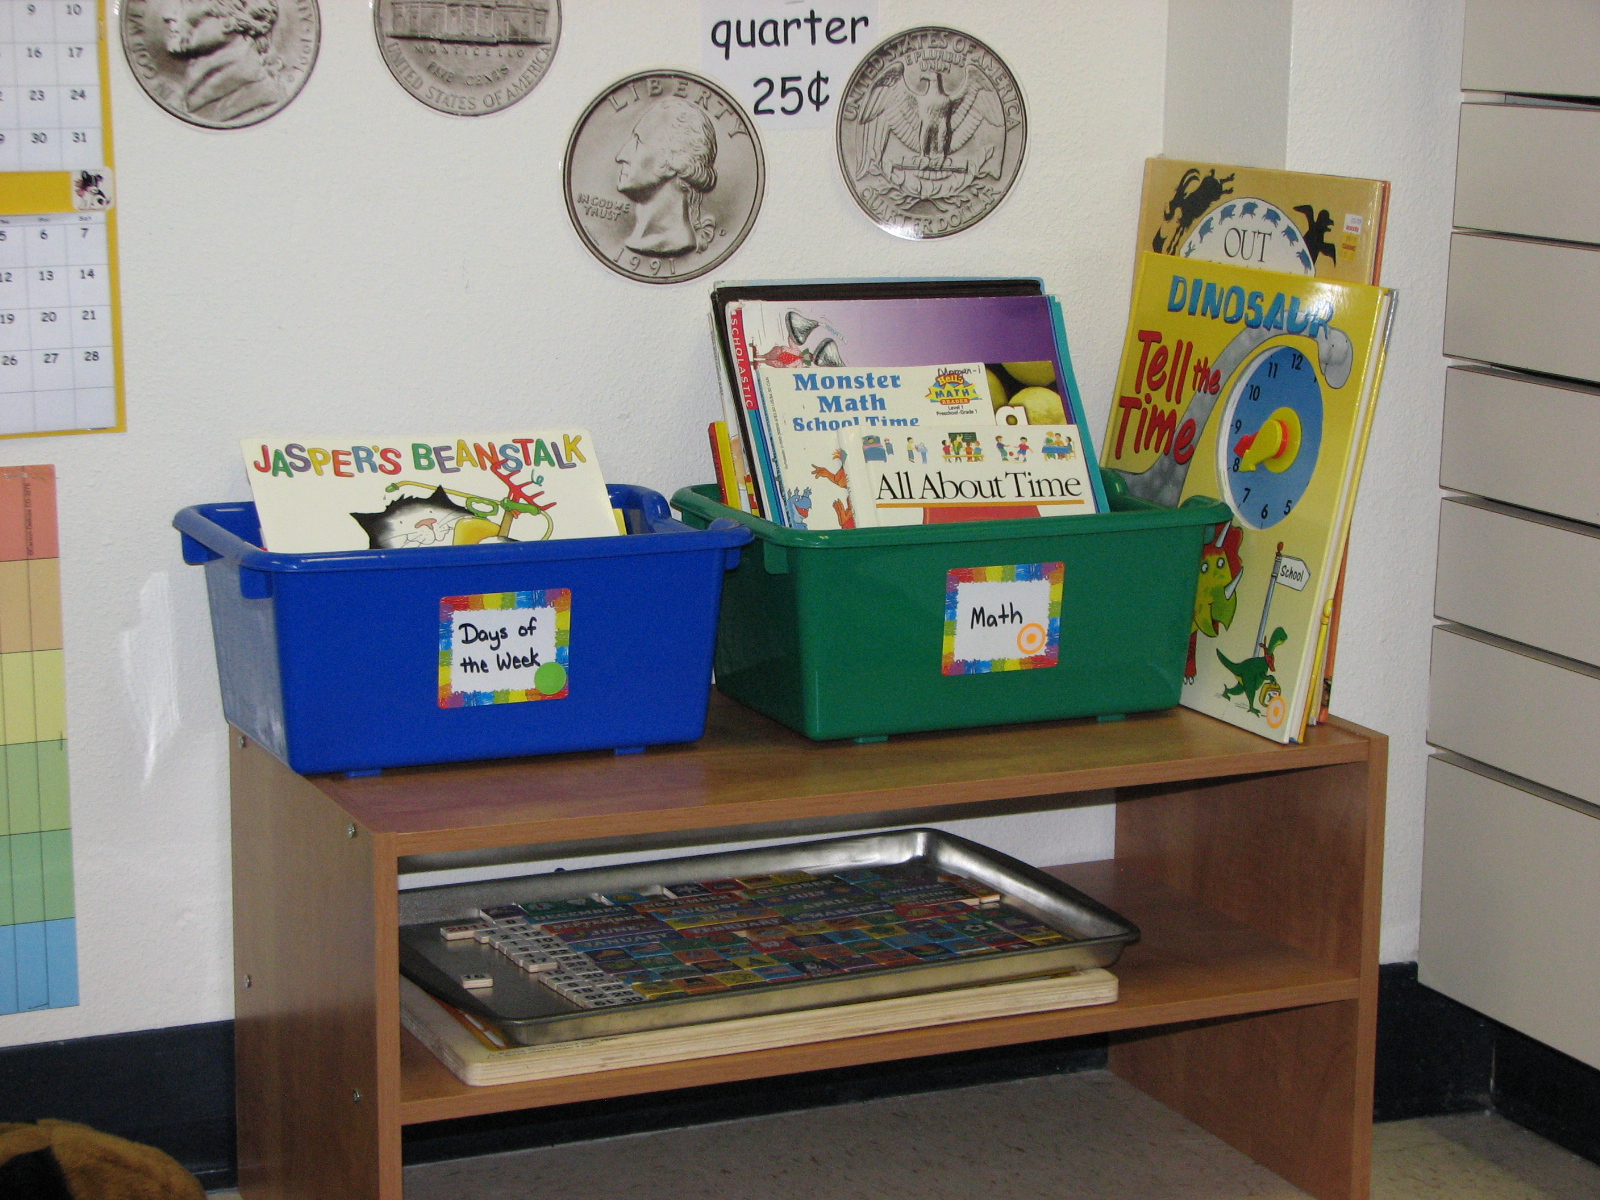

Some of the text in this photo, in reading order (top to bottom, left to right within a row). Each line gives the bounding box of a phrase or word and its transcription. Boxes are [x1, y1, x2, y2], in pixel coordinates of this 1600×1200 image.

[27, 4, 82, 16] 9 10
[710, 9, 869, 61] quarter
[26, 47, 84, 59] 16 17
[914, 49, 968, 68] PLURIBUS
[386, 41, 552, 111] UNITED STATES OF AMERICA
[463, 64, 510, 87] CENTS
[843, 31, 1022, 133] UNITED STATES OF AMERICA
[29, 89, 87, 102] 23 24
[753, 70, 830, 116] 25¢
[608, 78, 749, 139] LIBERTY
[30, 133, 48, 145] 30
[72, 132, 88, 144] 31
[577, 192, 631, 215] IN GOD WE
[937, 188, 1003, 233] DOLLAR
[583, 205, 623, 222] TRUST
[40, 229, 48, 241] 6
[80, 227, 90, 239] 7
[1223, 226, 1273, 264] OUT
[613, 247, 677, 276] 1991
[38, 270, 55, 282] 13
[79, 268, 96, 280] 14
[1167, 274, 1335, 340] DINOSAUR
[0, 310, 97, 325] 19 20 21
[2, 350, 100, 366] 26 27 28
[729, 316, 756, 409] SCHOLASTIC
[1134, 329, 1222, 405] Tell the
[1291, 353, 1304, 371] 12
[1267, 361, 1279, 379] 11
[792, 371, 902, 392] Monster
[937, 374, 964, 386] Hello
[935, 388, 970, 398] MATH
[1249, 384, 1261, 402] 10
[817, 393, 888, 414] Math
[792, 415, 920, 433] School Time
[1114, 391, 1198, 466] Time
[1234, 418, 1243, 435] 9
[253, 433, 588, 479] JASPER'S BEANSTALK
[1232, 456, 1242, 473] 8
[875, 470, 1084, 501] All About Time
[1241, 486, 1252, 504] 7
[1260, 502, 1269, 520] 6
[1283, 499, 1294, 517] 5
[1279, 563, 1305, 584] School
[970, 601, 1024, 630] Math
[458, 616, 537, 651] Days of
[459, 646, 541, 674] the Week
[702, 912, 739, 921] MAY
[447, 923, 490, 933] 2011
[592, 925, 641, 936] JUNE
